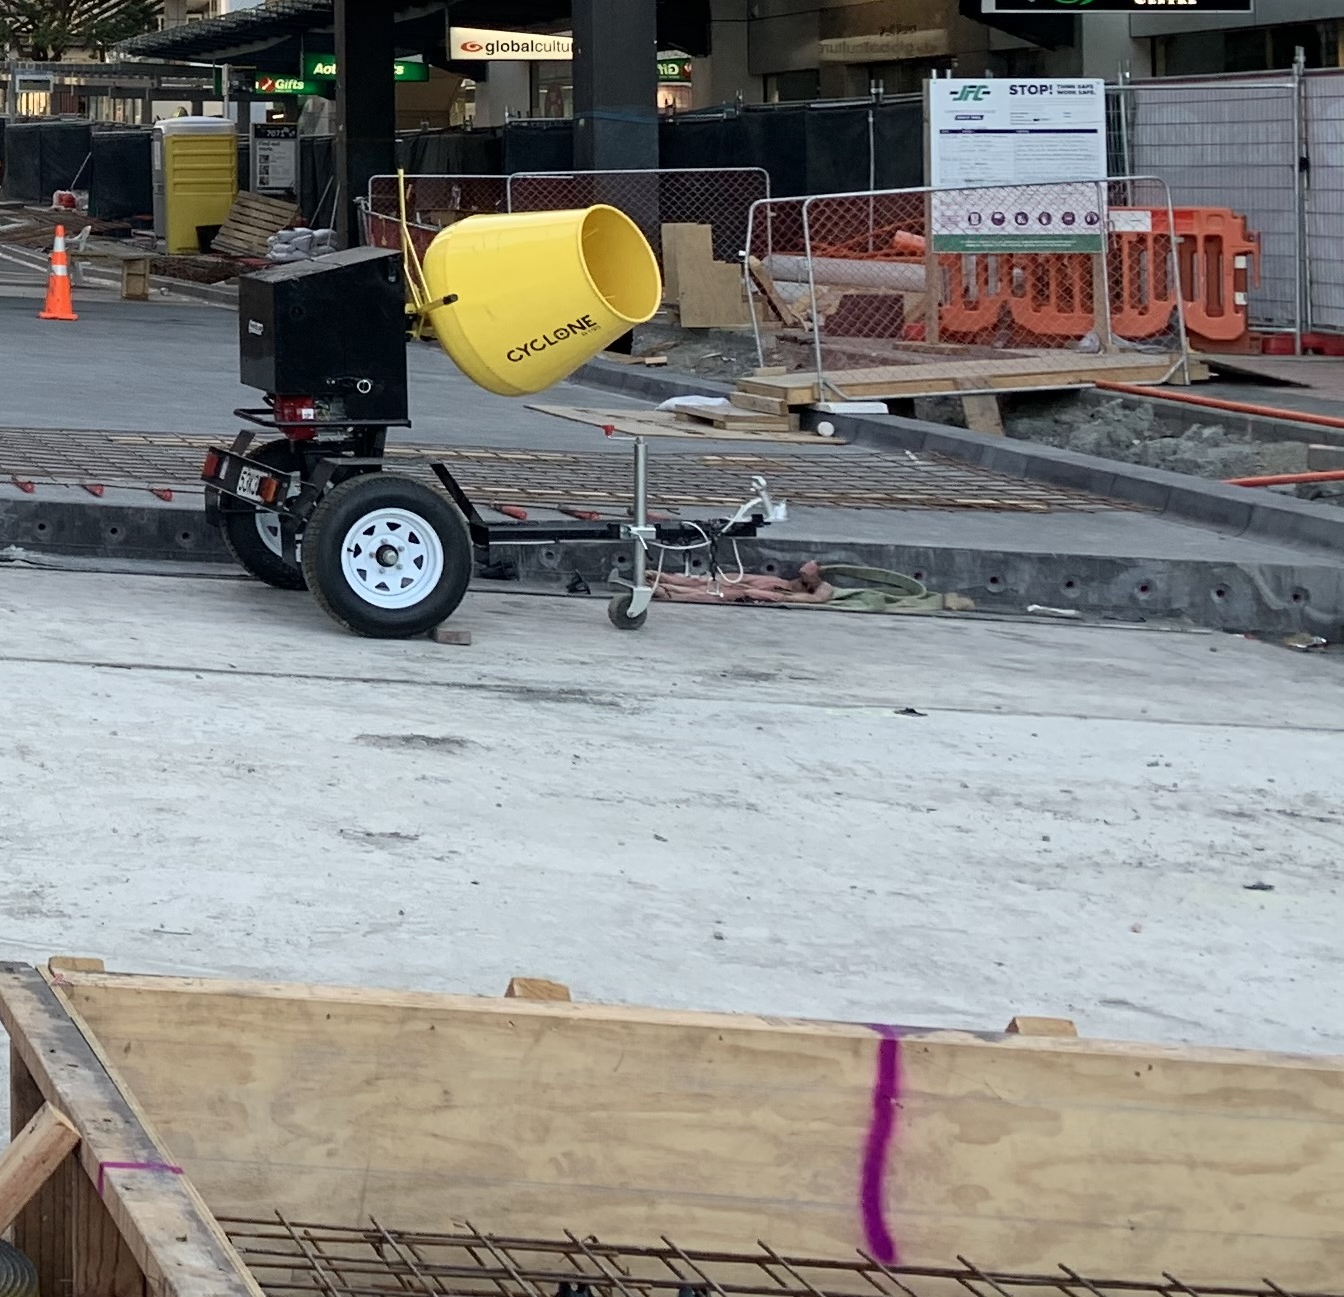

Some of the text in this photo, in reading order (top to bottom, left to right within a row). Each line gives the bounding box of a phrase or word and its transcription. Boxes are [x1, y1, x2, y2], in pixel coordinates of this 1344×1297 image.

[485, 39, 573, 56] globalcultu
[275, 78, 305, 90] Gifts
[1009, 84, 1053, 96] STOP!
[506, 314, 598, 363] CYCLONE
